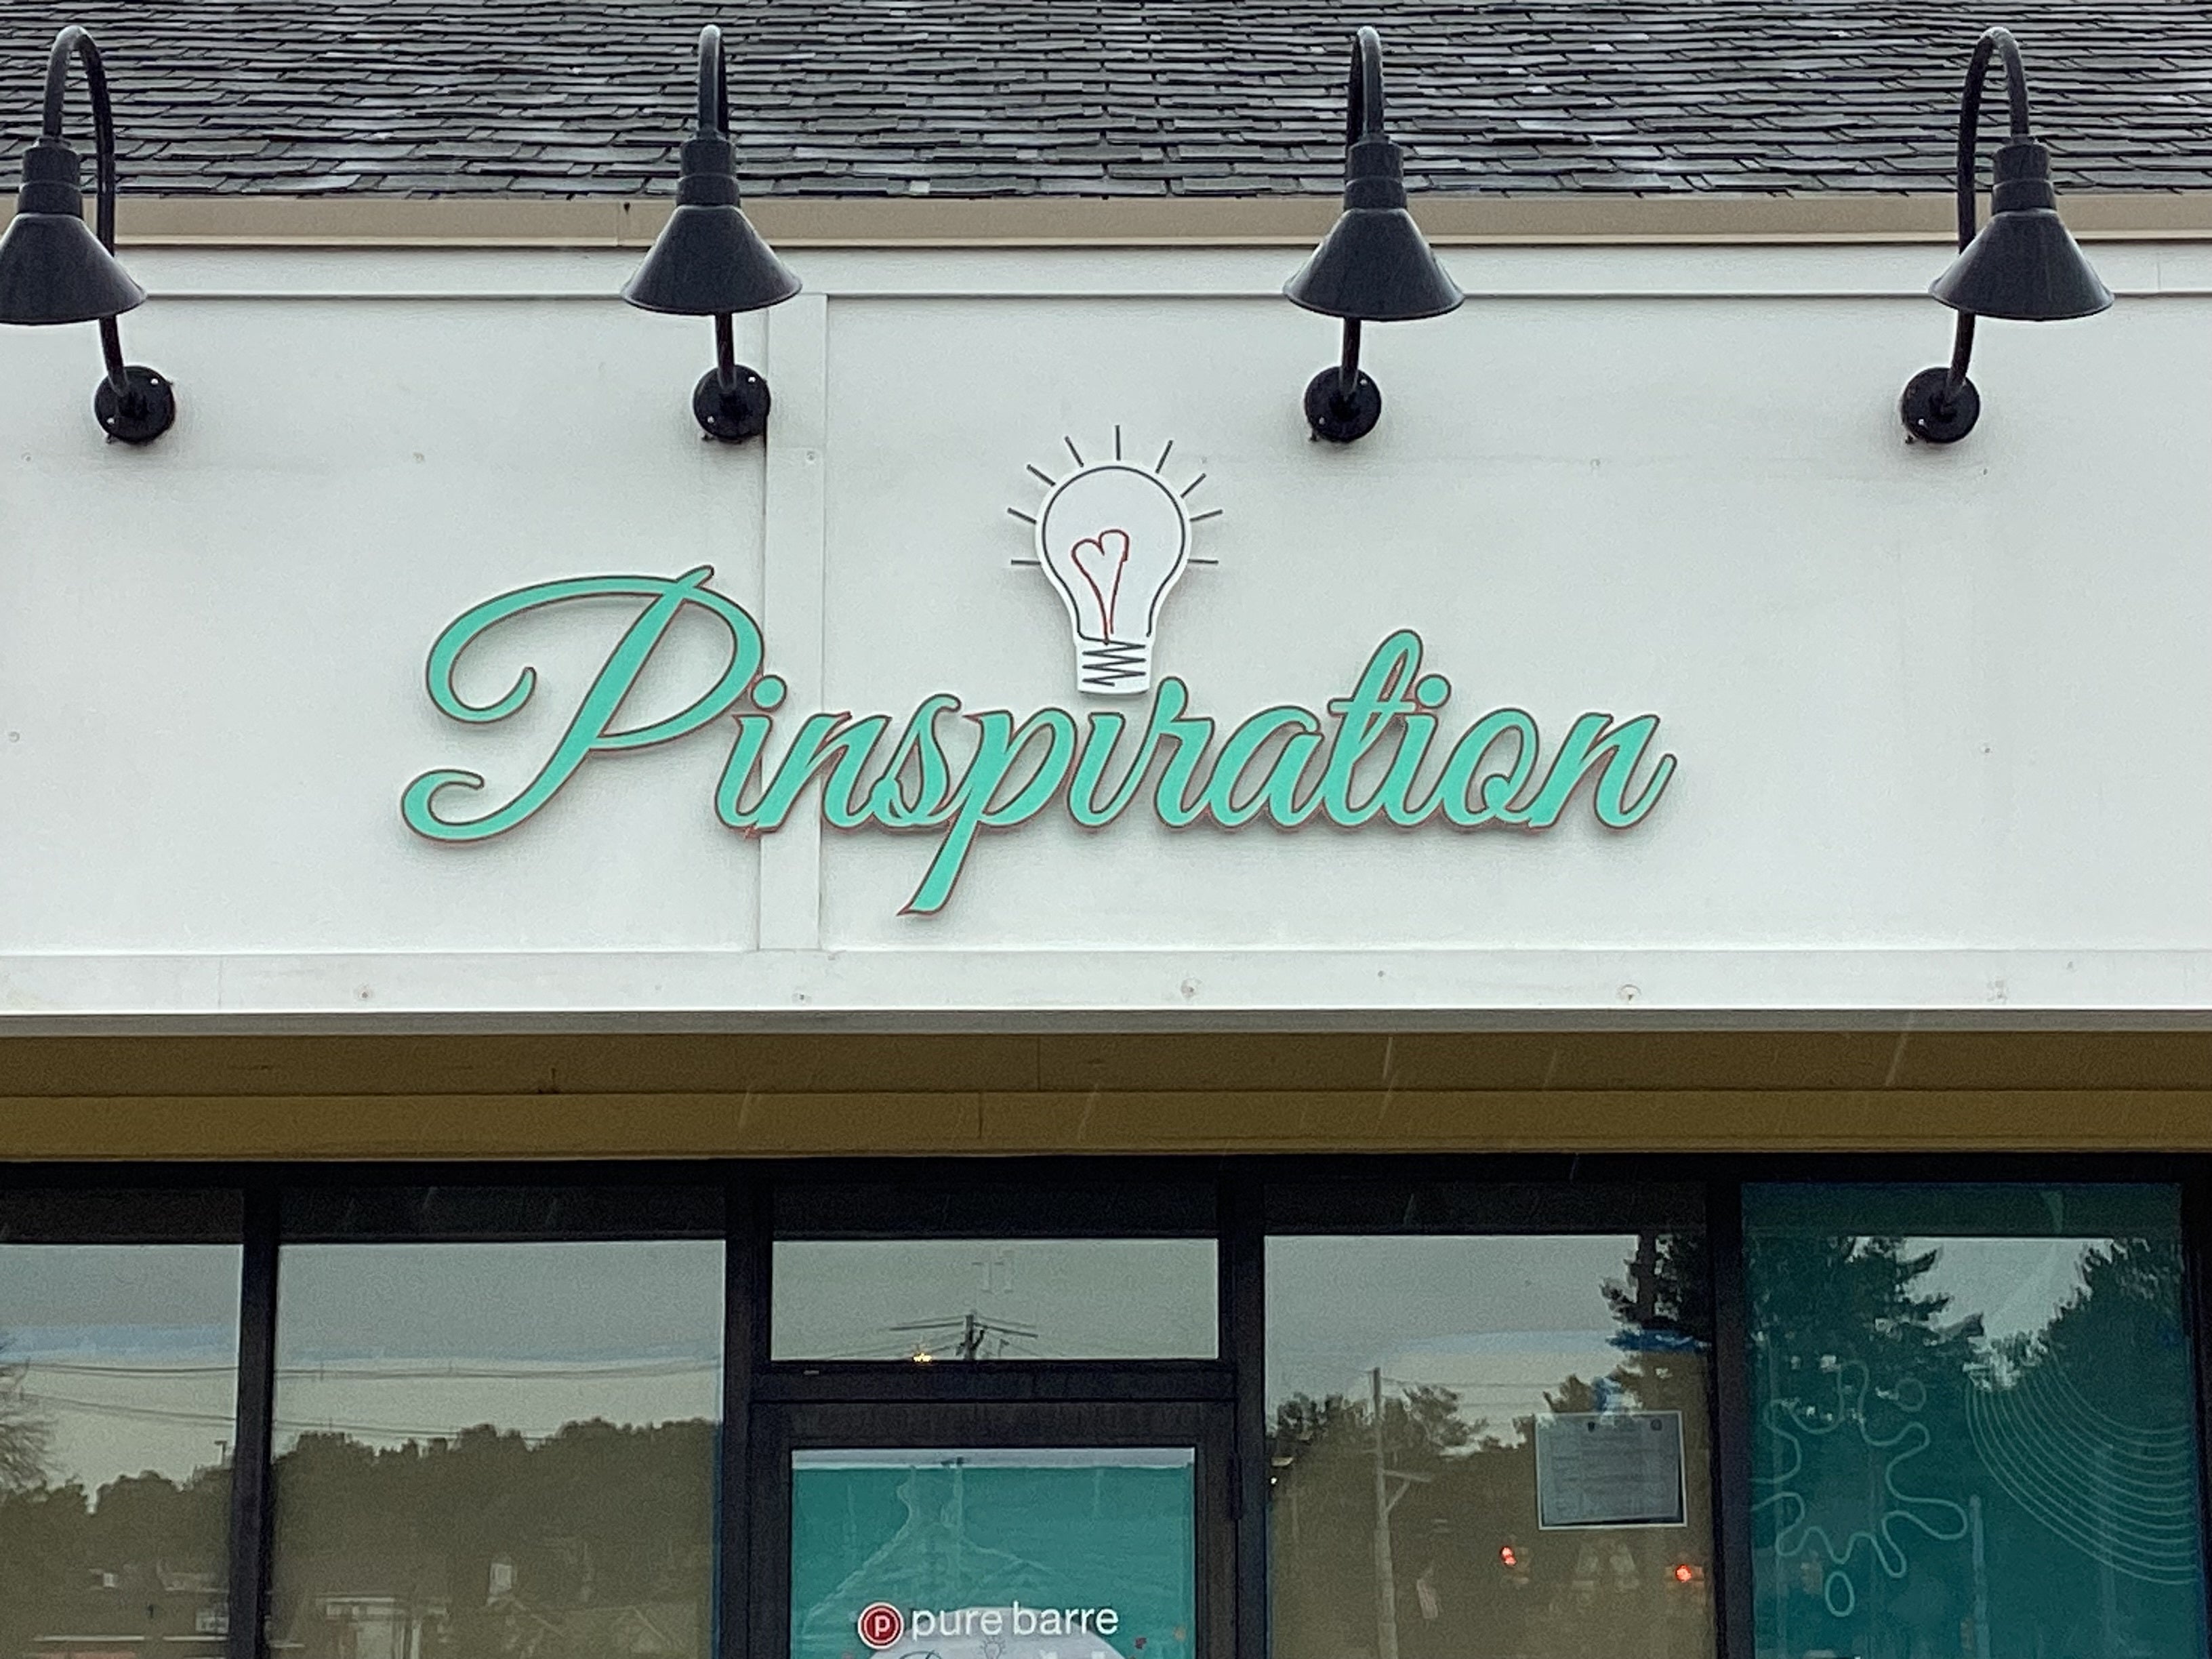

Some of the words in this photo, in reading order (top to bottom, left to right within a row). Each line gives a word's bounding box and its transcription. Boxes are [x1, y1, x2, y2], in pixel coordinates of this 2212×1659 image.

[402, 565, 1677, 916] Pinspiration
[912, 1610, 1003, 1642] pure
[1013, 1600, 1120, 1635] barre
